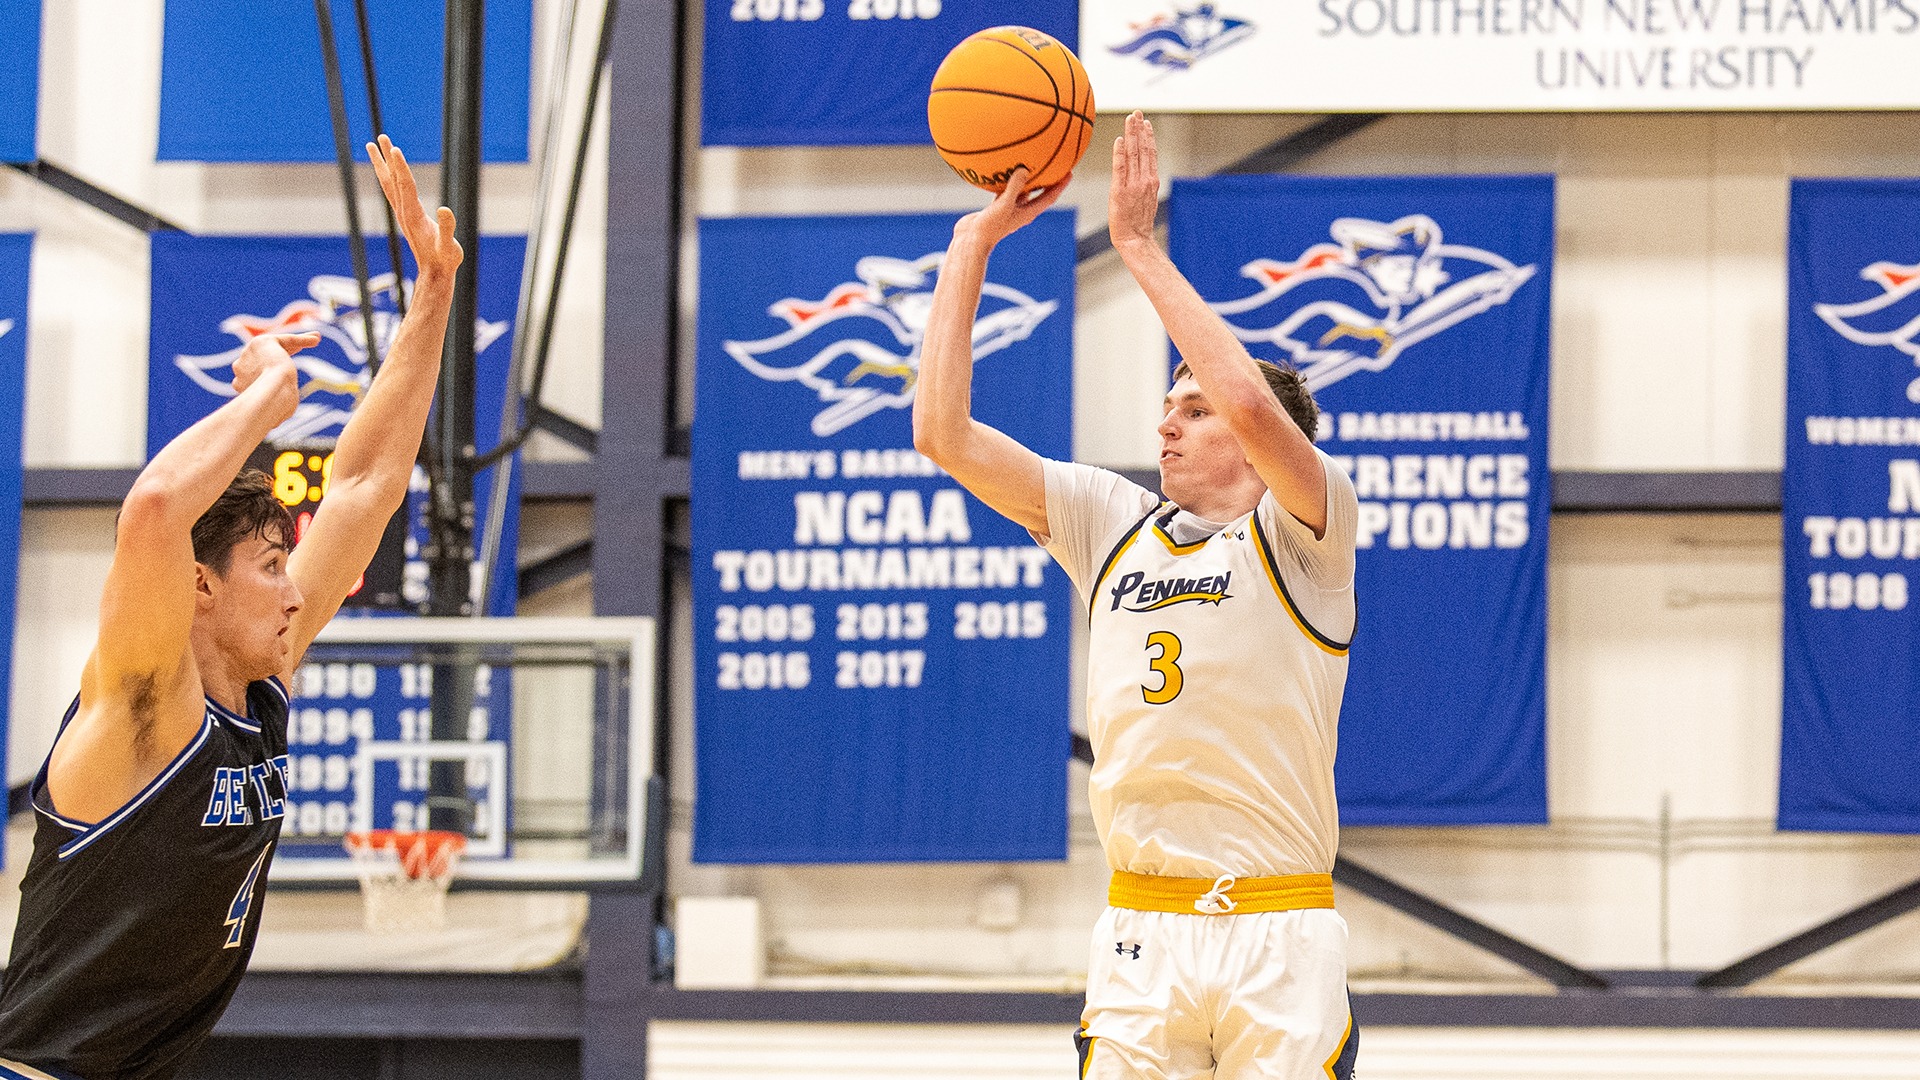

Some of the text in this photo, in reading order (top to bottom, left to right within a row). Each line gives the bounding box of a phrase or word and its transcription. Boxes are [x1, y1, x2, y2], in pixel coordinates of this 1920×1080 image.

[1318, 0, 1583, 36] SOUTHERN
[1603, 0, 1717, 34] NEW
[1536, 47, 1814, 90] UNIVERSITY
[1338, 411, 1530, 441] BASKETBALL
[739, 449, 951, 480] MEN'S BASKE
[794, 490, 971, 545] NCAA
[713, 547, 1049, 592] TOURNAMENT
[715, 601, 1047, 642] 2005 2013 2015
[717, 650, 926, 689] 2016 2017
[1141, 631, 1184, 705] 3
[223, 840, 272, 950] 4
